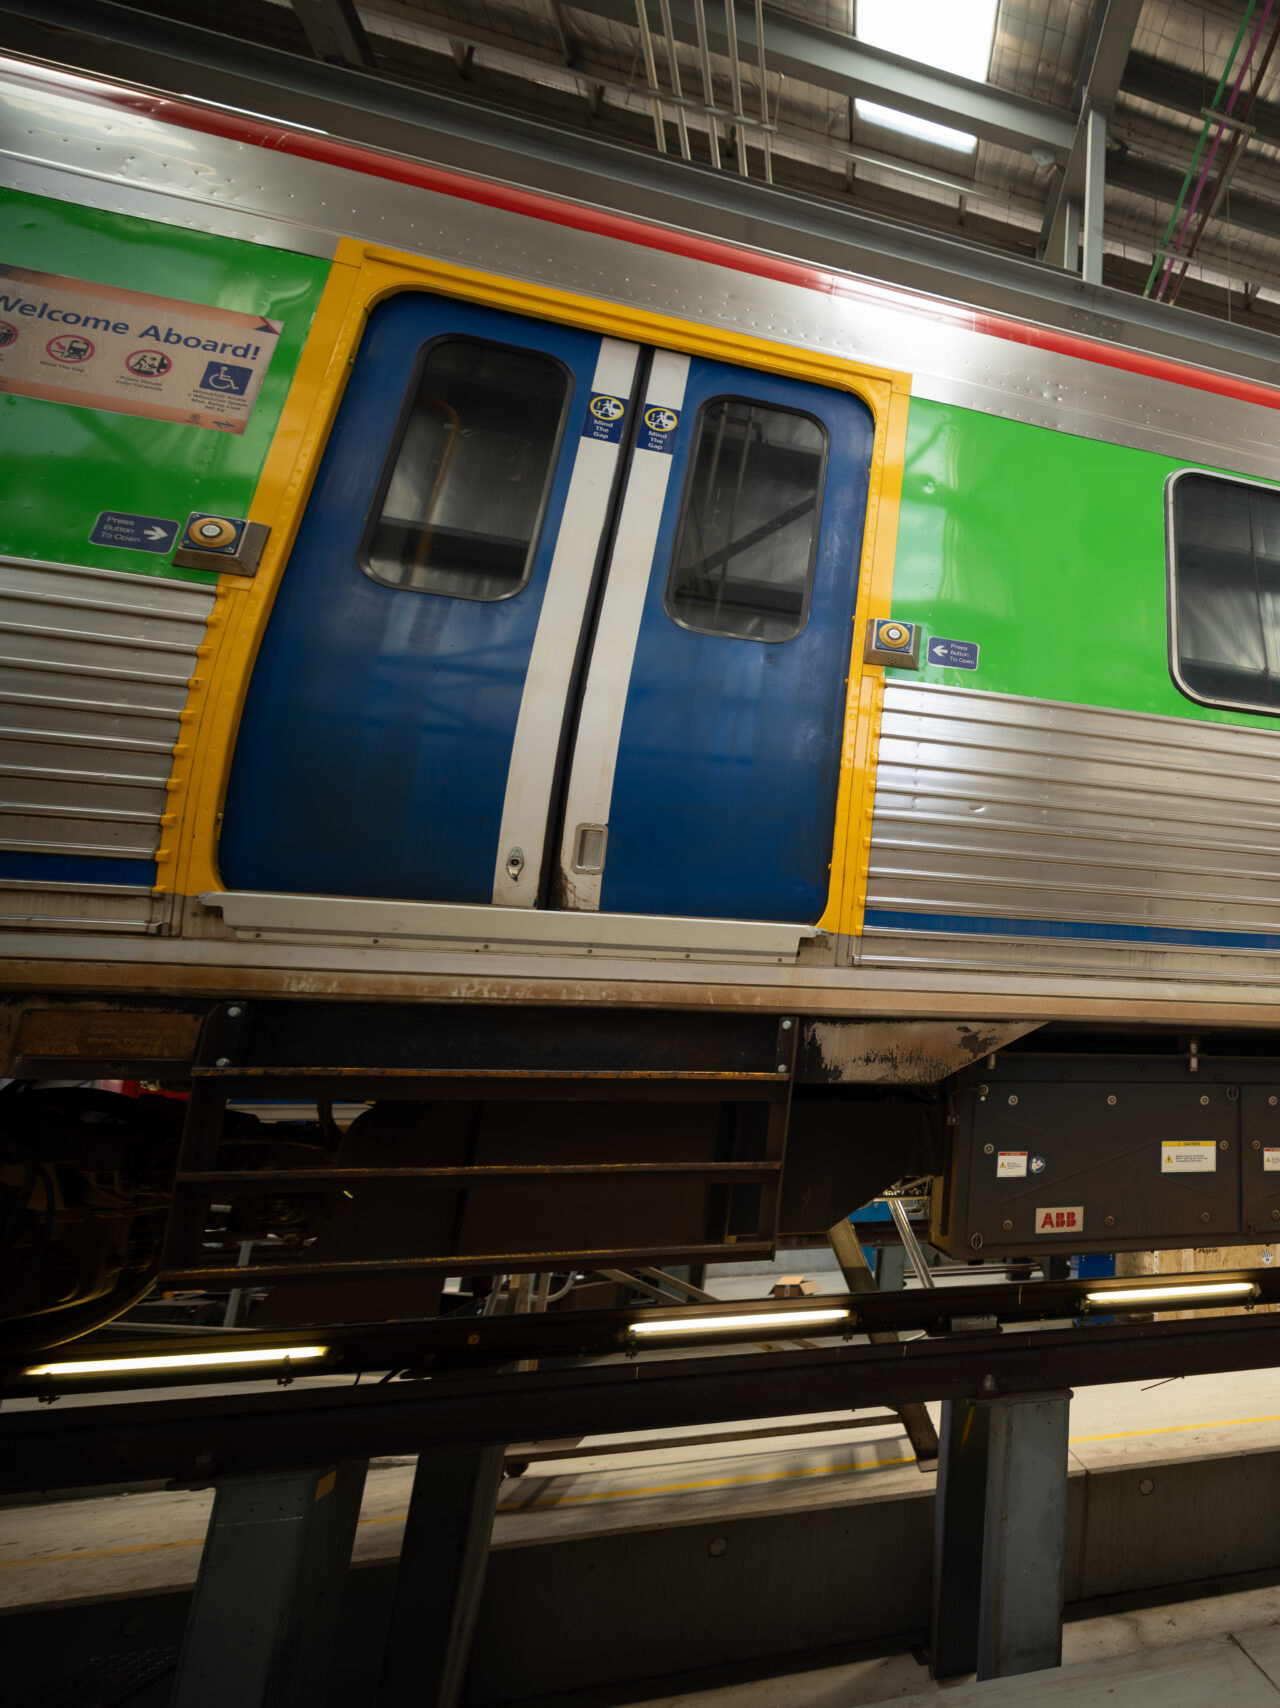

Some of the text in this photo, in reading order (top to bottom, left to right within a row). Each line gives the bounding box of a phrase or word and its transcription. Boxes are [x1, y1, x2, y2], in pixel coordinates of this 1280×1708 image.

[0, 295, 260, 360] Welcome Aboard!
[593, 419, 614, 428] Mind
[595, 425, 610, 433] The
[593, 431, 609, 439] Gap
[648, 431, 668, 439] Mind
[648, 442, 663, 450] Gap
[106, 516, 135, 526] Press
[103, 524, 135, 533] Button
[114, 533, 141, 543] Open
[950, 643, 968, 651] Press
[958, 657, 975, 665] Open
[1041, 1211, 1077, 1229] ABB
